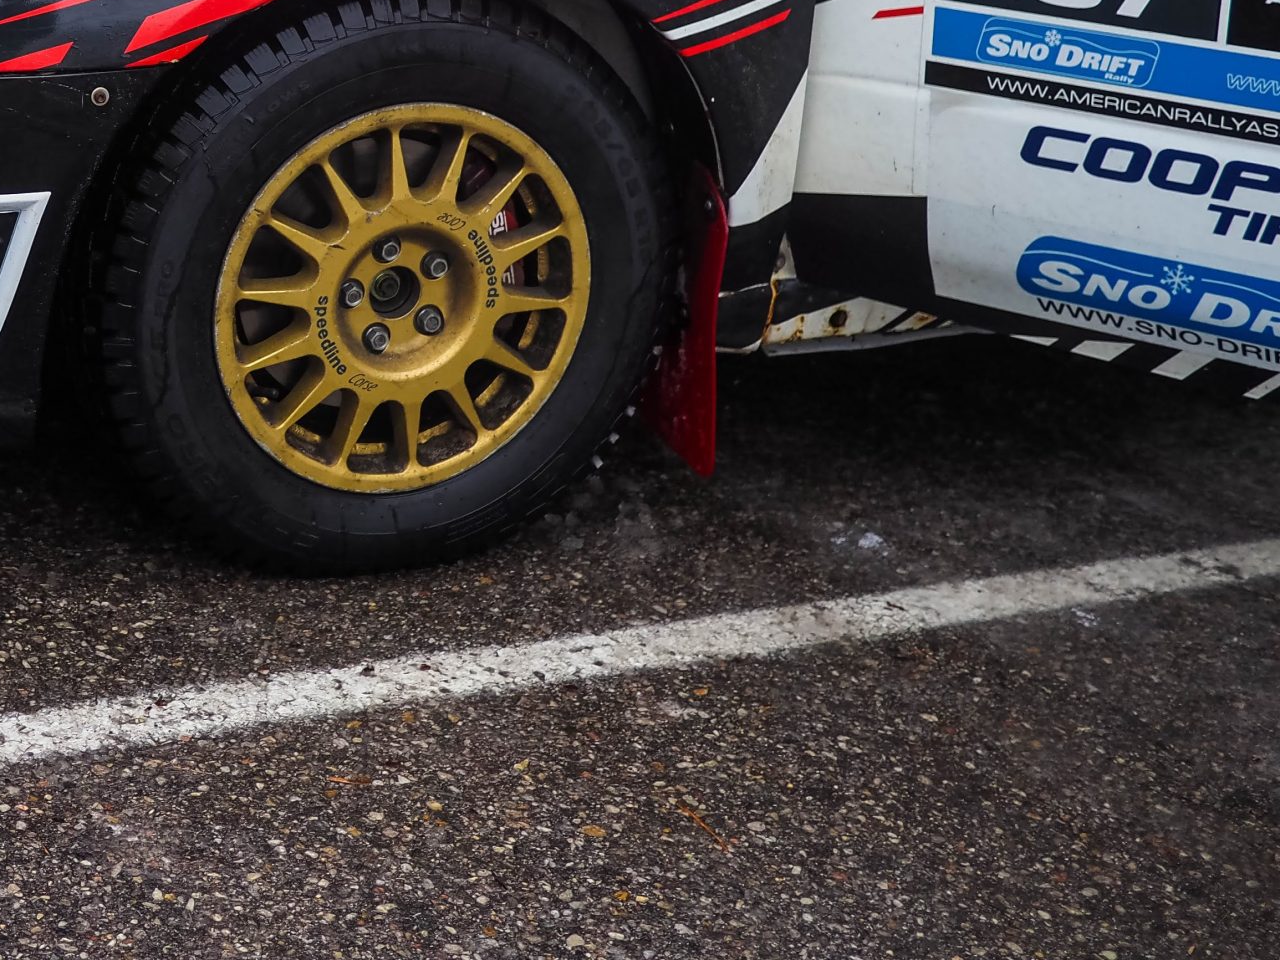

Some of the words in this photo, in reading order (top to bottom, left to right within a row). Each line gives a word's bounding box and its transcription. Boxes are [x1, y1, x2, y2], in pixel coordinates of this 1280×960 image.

[986, 33, 1050, 62] SNO
[1055, 44, 1146, 77] DRIFT
[1104, 73, 1135, 85] Rally
[467, 229, 500, 309] speedline
[1031, 260, 1171, 311] SNO
[314, 295, 348, 376] speedline
